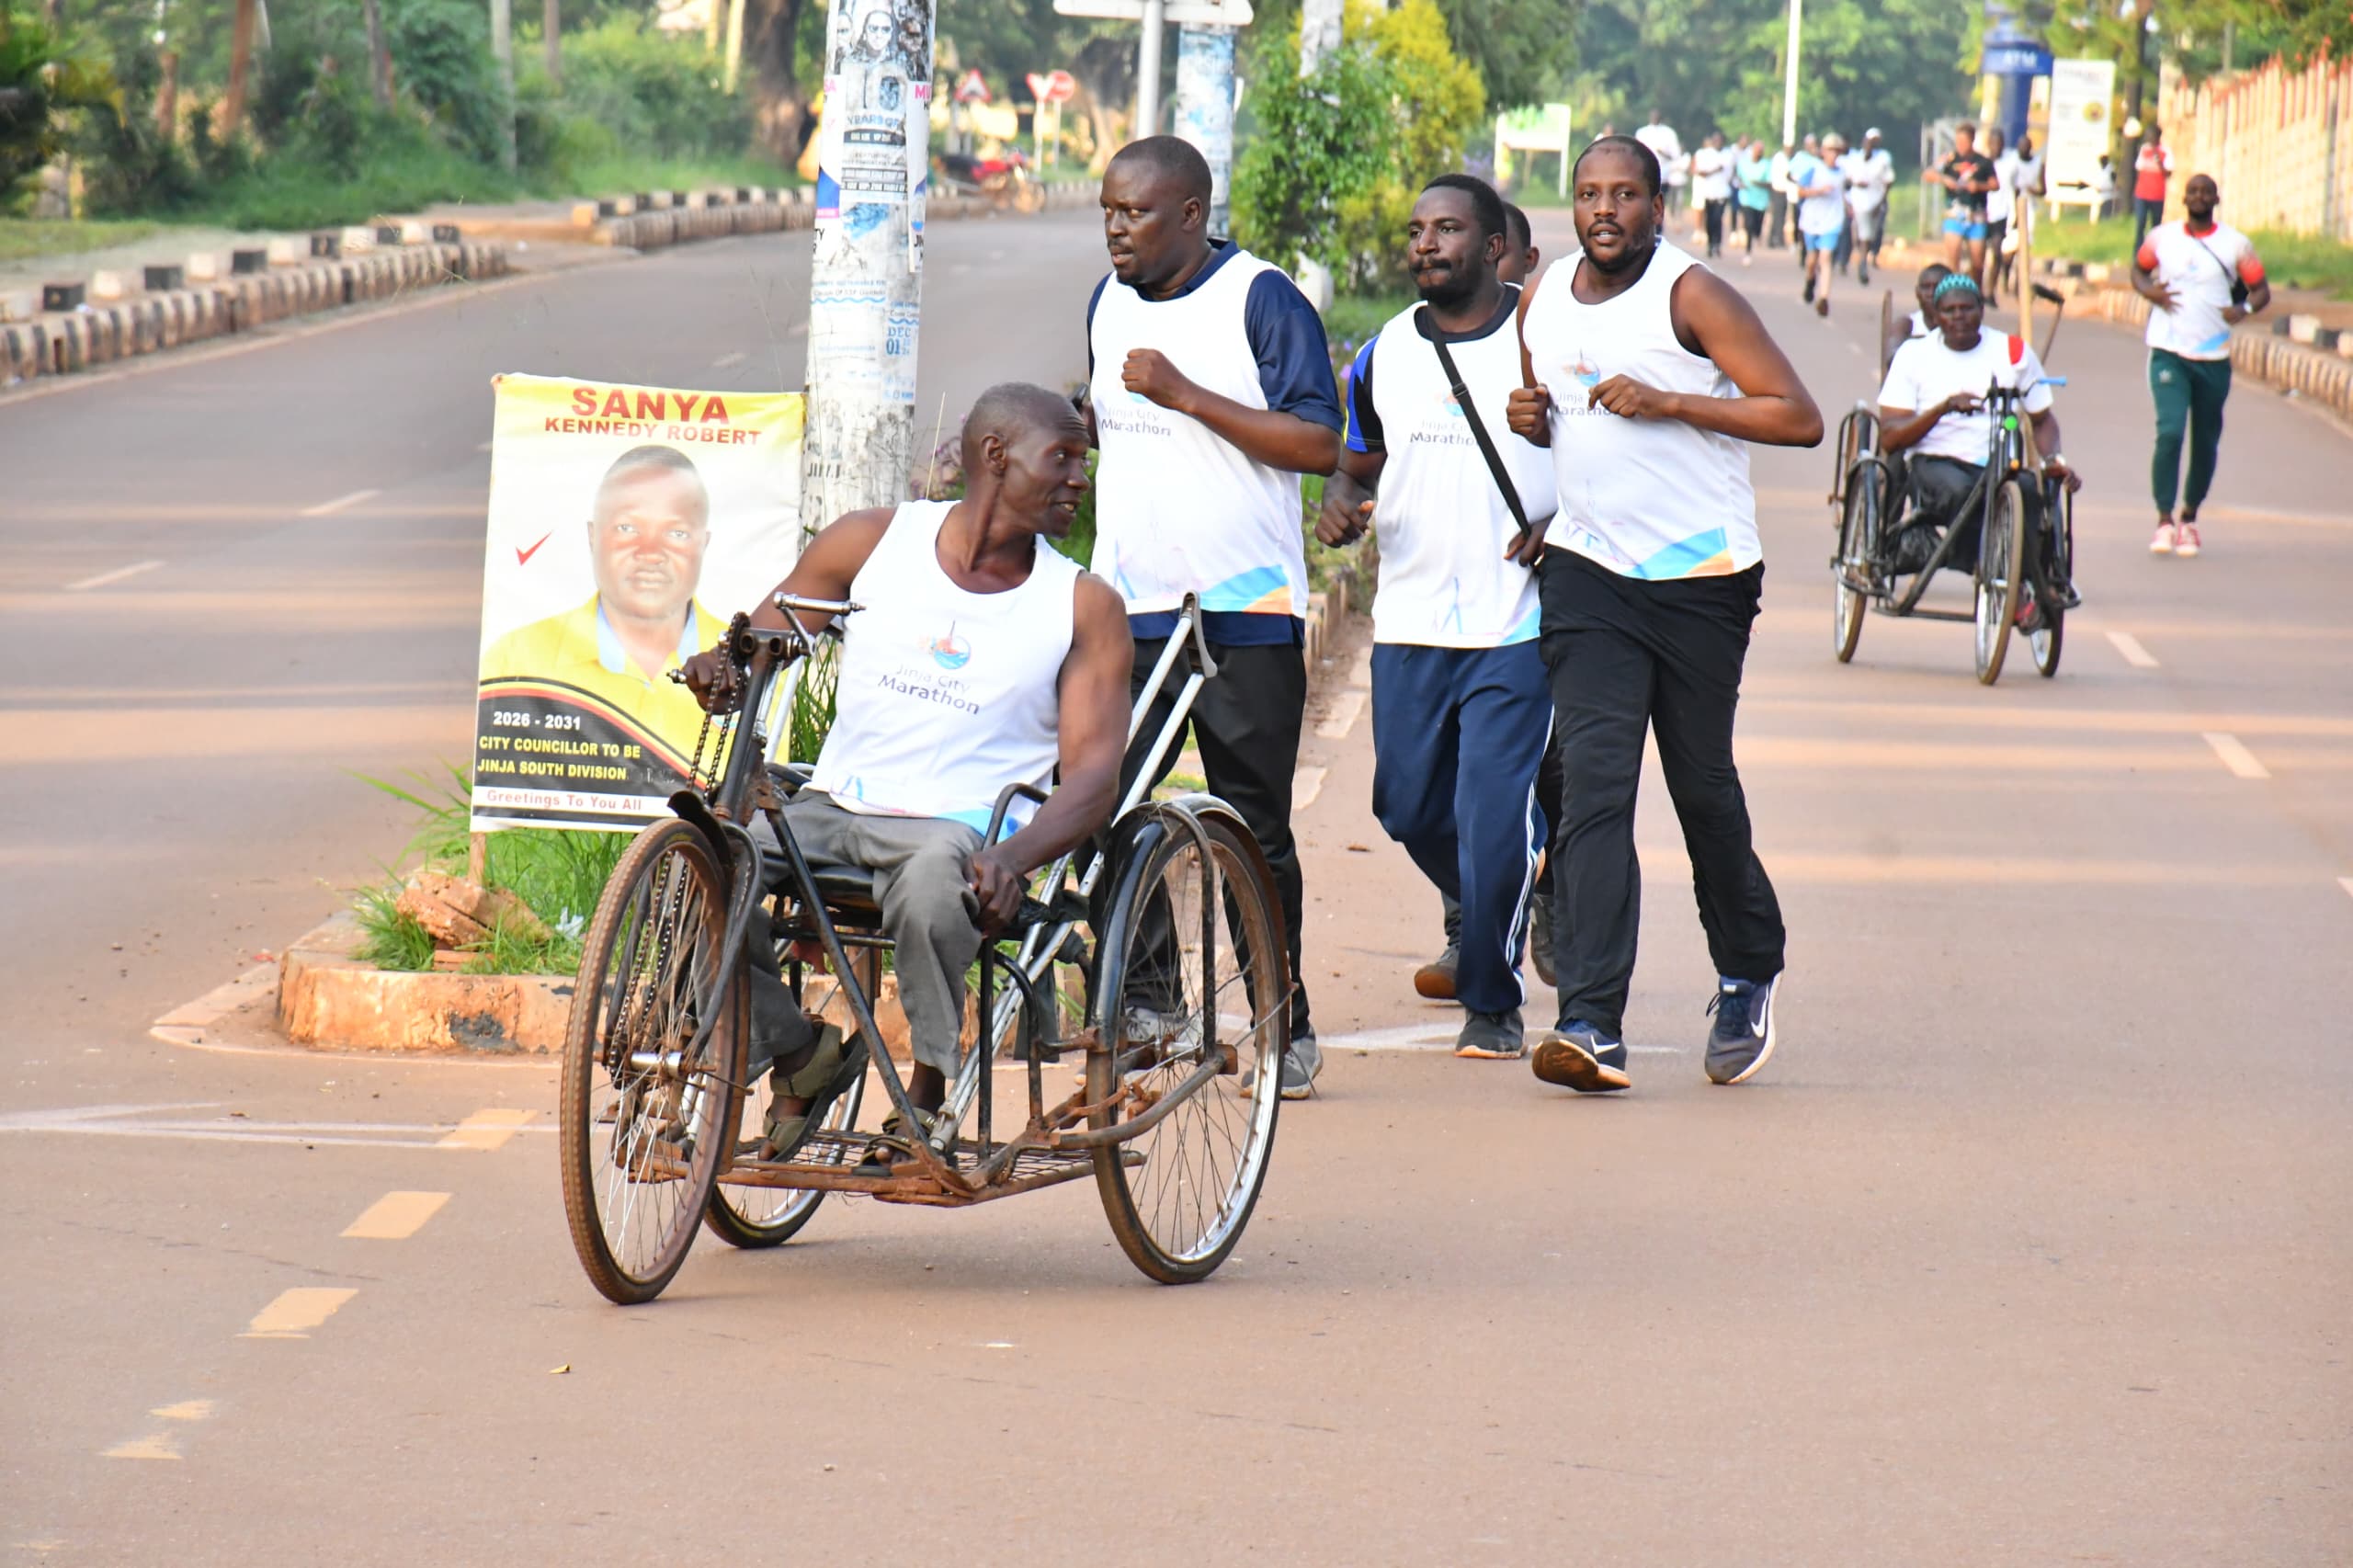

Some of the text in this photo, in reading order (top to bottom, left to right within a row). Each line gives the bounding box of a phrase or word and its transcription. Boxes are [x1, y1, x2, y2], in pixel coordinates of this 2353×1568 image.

[887, 326, 911, 338] DEC
[571, 386, 730, 425] SANYA
[545, 417, 762, 446] KENNEDY ROBERT
[1101, 418, 1172, 437] Marathon
[1410, 431, 1475, 446] Maratho
[878, 675, 980, 715] Marathon
[938, 676, 972, 695] City
[493, 710, 530, 727] 2026
[544, 714, 581, 731] 2031
[479, 735, 641, 759] CITY COUNCILLOR TO BE
[477, 758, 626, 780] JINJA SOUTH DIVISION
[486, 789, 642, 811] Greetings To You All
